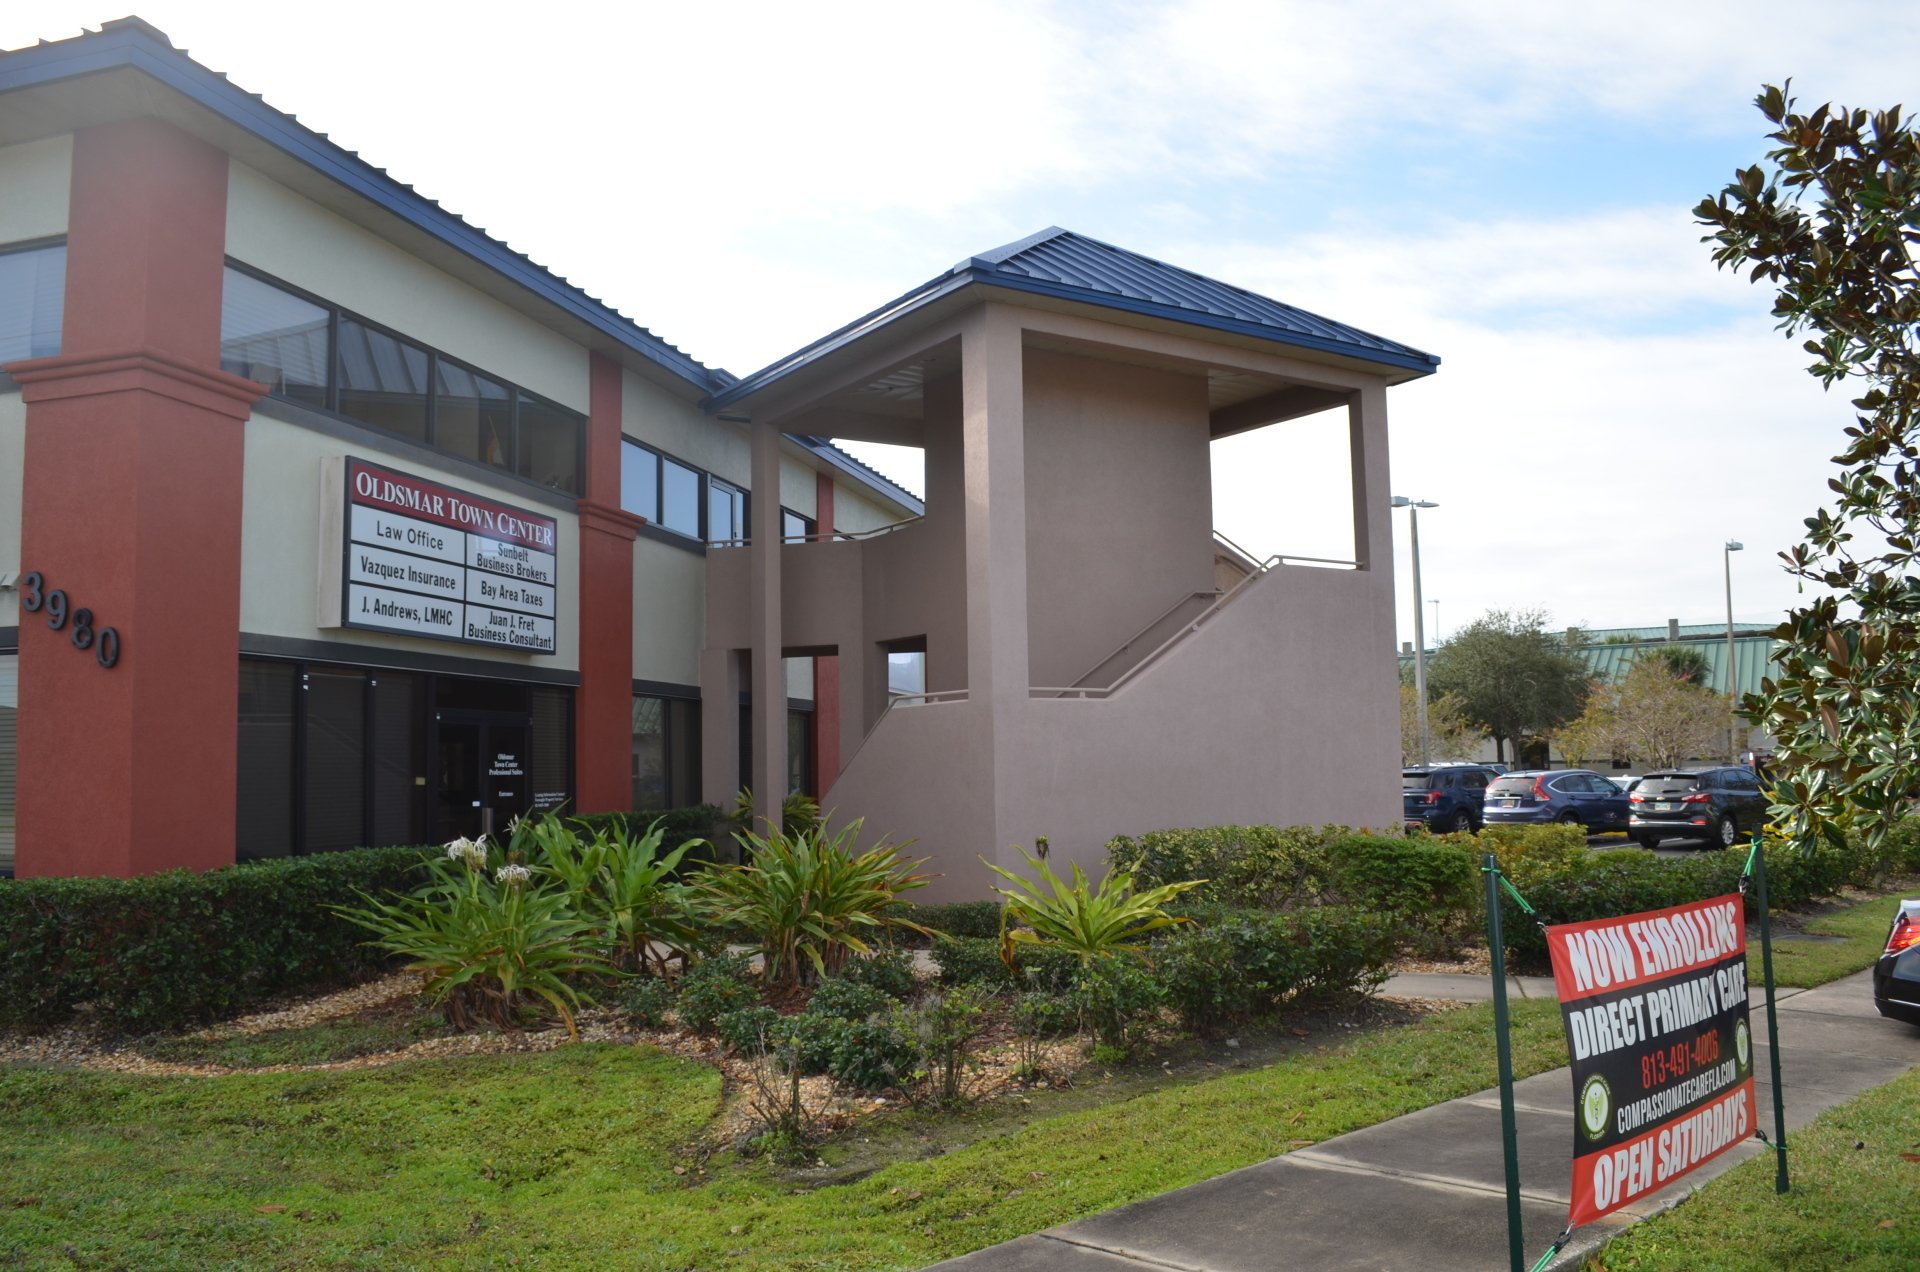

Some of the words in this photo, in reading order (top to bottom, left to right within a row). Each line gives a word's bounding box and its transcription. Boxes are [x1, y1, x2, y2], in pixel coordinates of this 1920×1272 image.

[356, 472, 444, 517] OLDSMAR
[448, 497, 494, 530] TOWN
[497, 512, 552, 546] CENTER
[376, 520, 402, 540] Law
[407, 528, 443, 550] Office
[477, 553, 514, 576] Business
[517, 562, 547, 582] Brokers
[497, 543, 529, 563] Sunbelt
[361, 555, 404, 580] Vazquez
[408, 565, 456, 590] Insurance
[362, 596, 370, 613] J.
[373, 598, 421, 624] Andrews,
[424, 606, 453, 626] LMHC
[481, 580, 497, 600] Bay
[500, 585, 518, 602] Area
[521, 589, 543, 607] Taxes
[23, 571, 120, 669] 3980
[468, 623, 506, 642] Business
[509, 630, 551, 649] Consultant
[489, 611, 508, 628] Juan
[509, 614, 516, 629] J.
[518, 616, 535, 632] Fret
[1565, 925, 1636, 993] NOW
[1628, 902, 1737, 977] ENROLLING
[1569, 995, 1646, 1061] DIRECT
[1646, 973, 1718, 1037] PRIMARY
[1717, 961, 1746, 1012] CARE
[1641, 1028, 1719, 1089] 813-491-4006
[1617, 1058, 1737, 1134] COMPASSIONATECAREFLA.COM
[1594, 1136, 1655, 1211] OPEN
[1657, 1088, 1748, 1183] SATURDAYS
